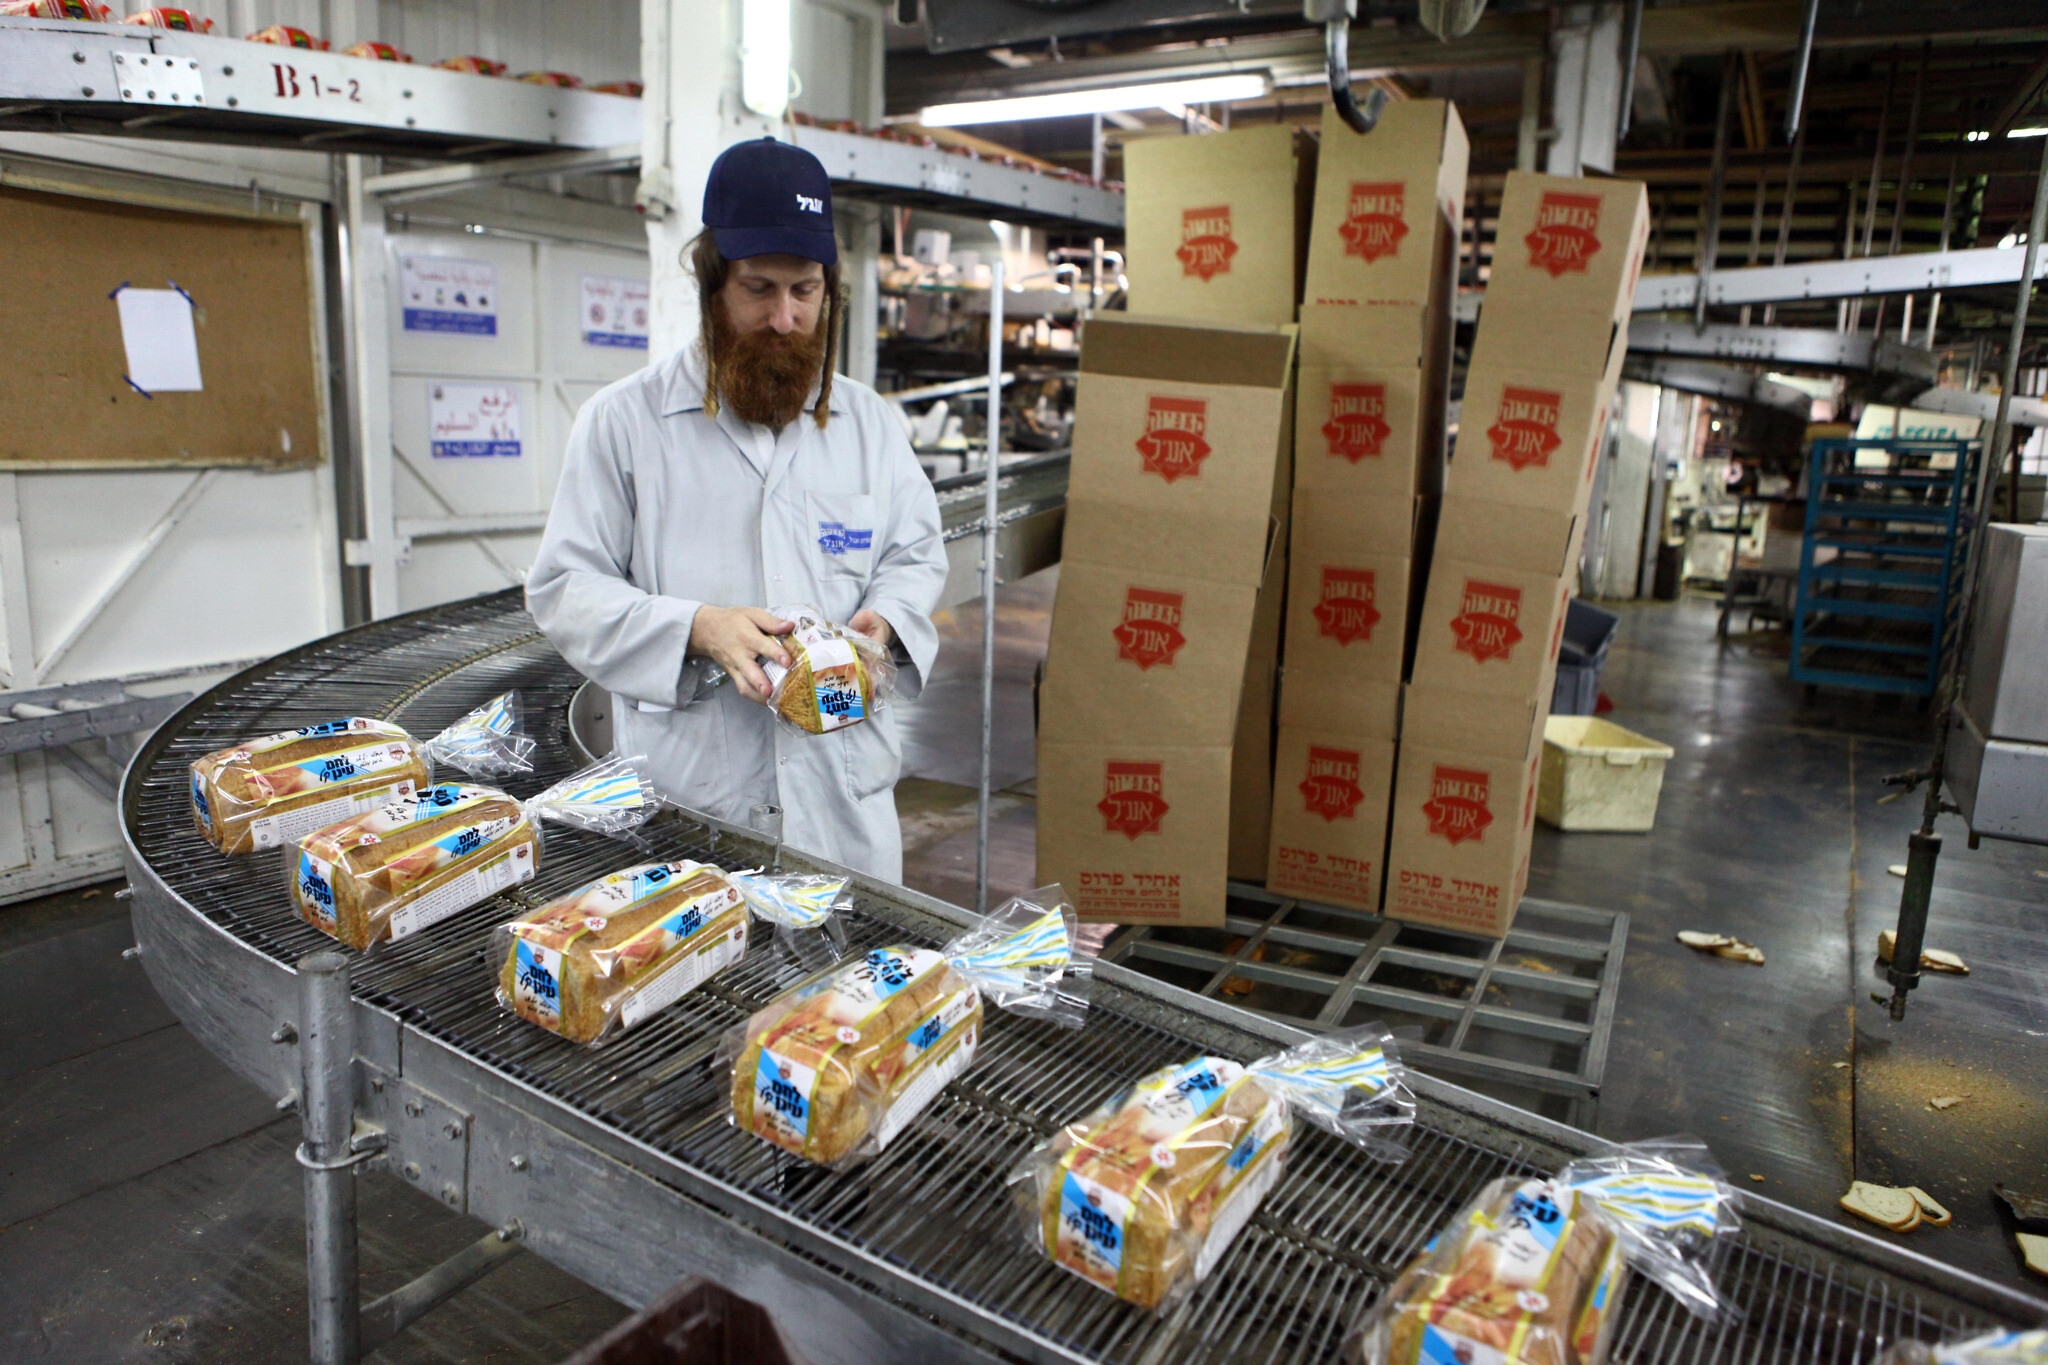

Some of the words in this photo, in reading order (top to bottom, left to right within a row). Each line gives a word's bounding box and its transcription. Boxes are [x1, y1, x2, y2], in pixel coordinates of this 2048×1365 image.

[271, 63, 300, 97] B
[826, 700, 850, 716] לחם
[325, 754, 350, 770] לחם
[459, 827, 480, 845] לחם
[1278, 846, 1320, 866] פרוס
[1325, 854, 1372, 873] אחיד
[309, 875, 328, 893] לחם
[1080, 872, 1125, 886] פרוס
[1132, 873, 1181, 888] אחיד
[1399, 869, 1443, 889] פרוס
[1452, 878, 1500, 899] אחיד
[682, 904, 700, 925] לחם
[530, 965, 552, 985] לחם
[773, 1079, 802, 1103] לחם
[1082, 1206, 1115, 1233] לחם
